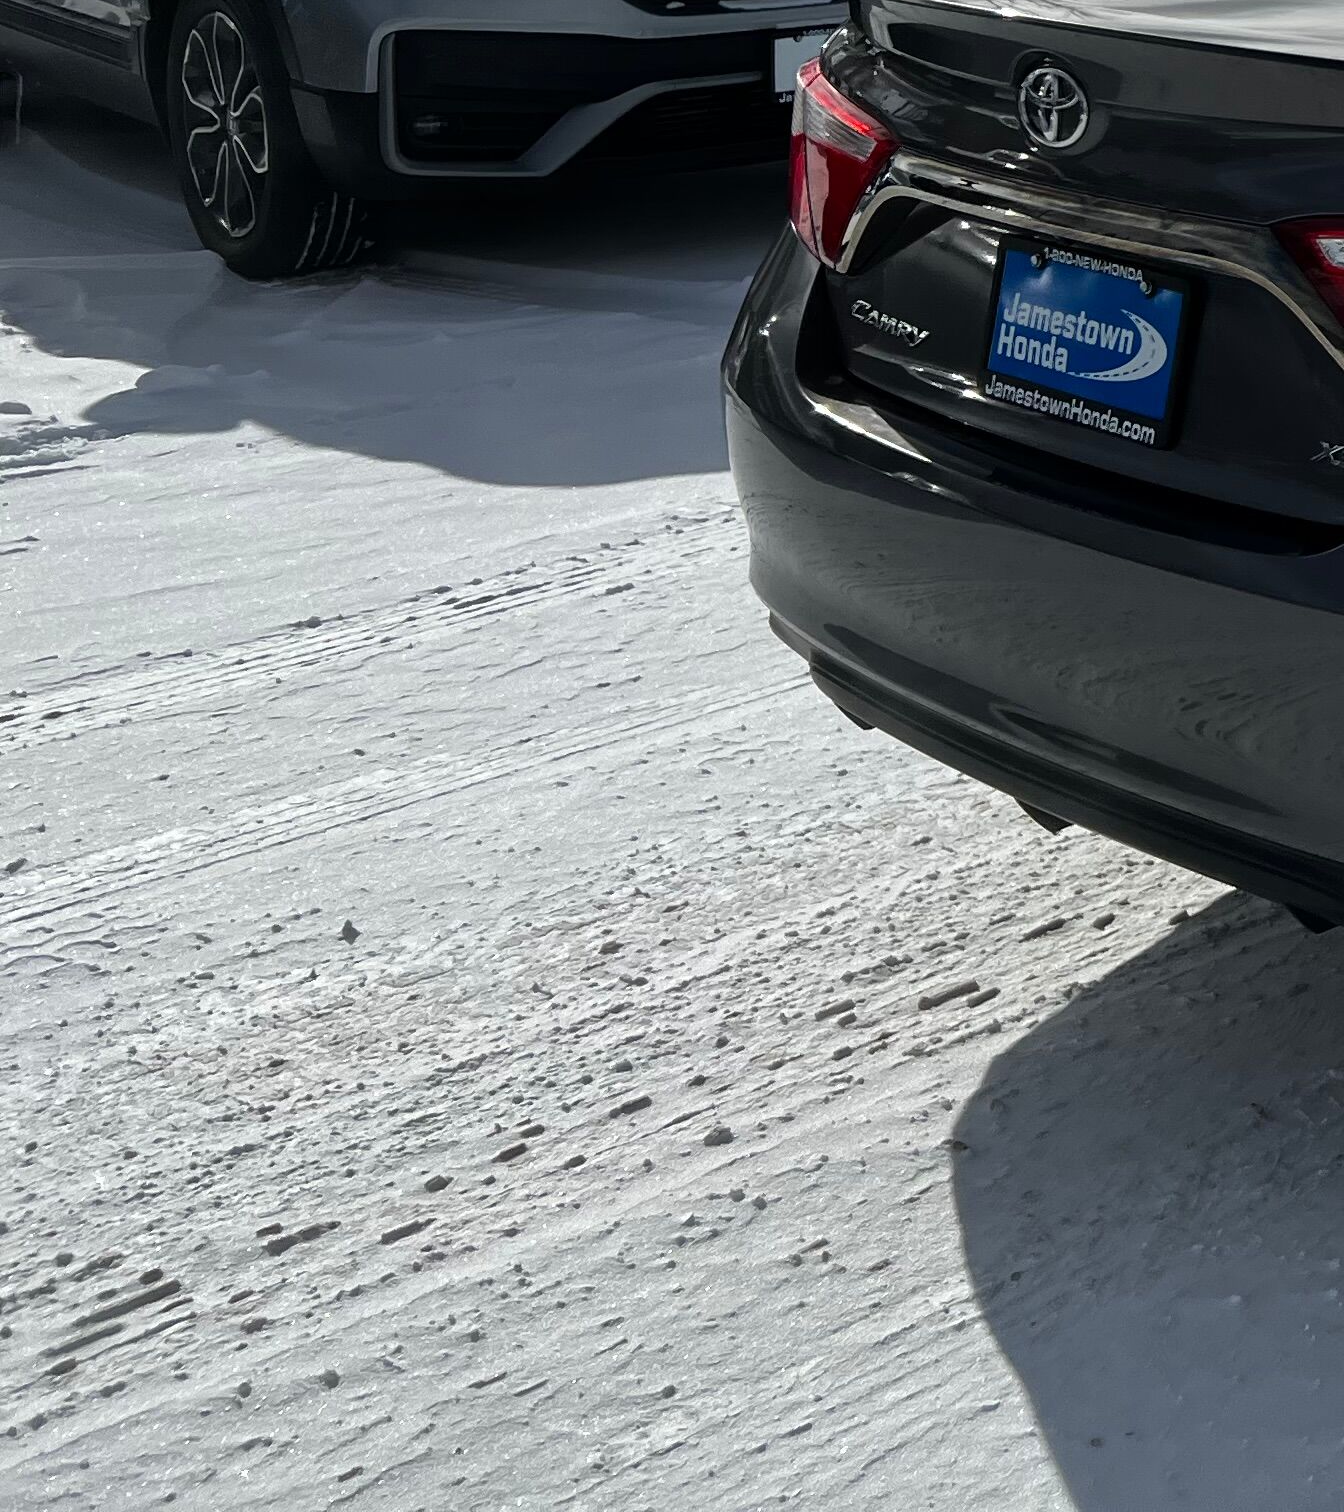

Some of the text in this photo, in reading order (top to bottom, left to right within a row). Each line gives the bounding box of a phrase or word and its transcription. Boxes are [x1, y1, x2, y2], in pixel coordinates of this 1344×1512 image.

[997, 322, 1069, 373] Honda
[1003, 292, 1135, 355] Jamestown
[985, 374, 1156, 445] JamestownHonda.com
